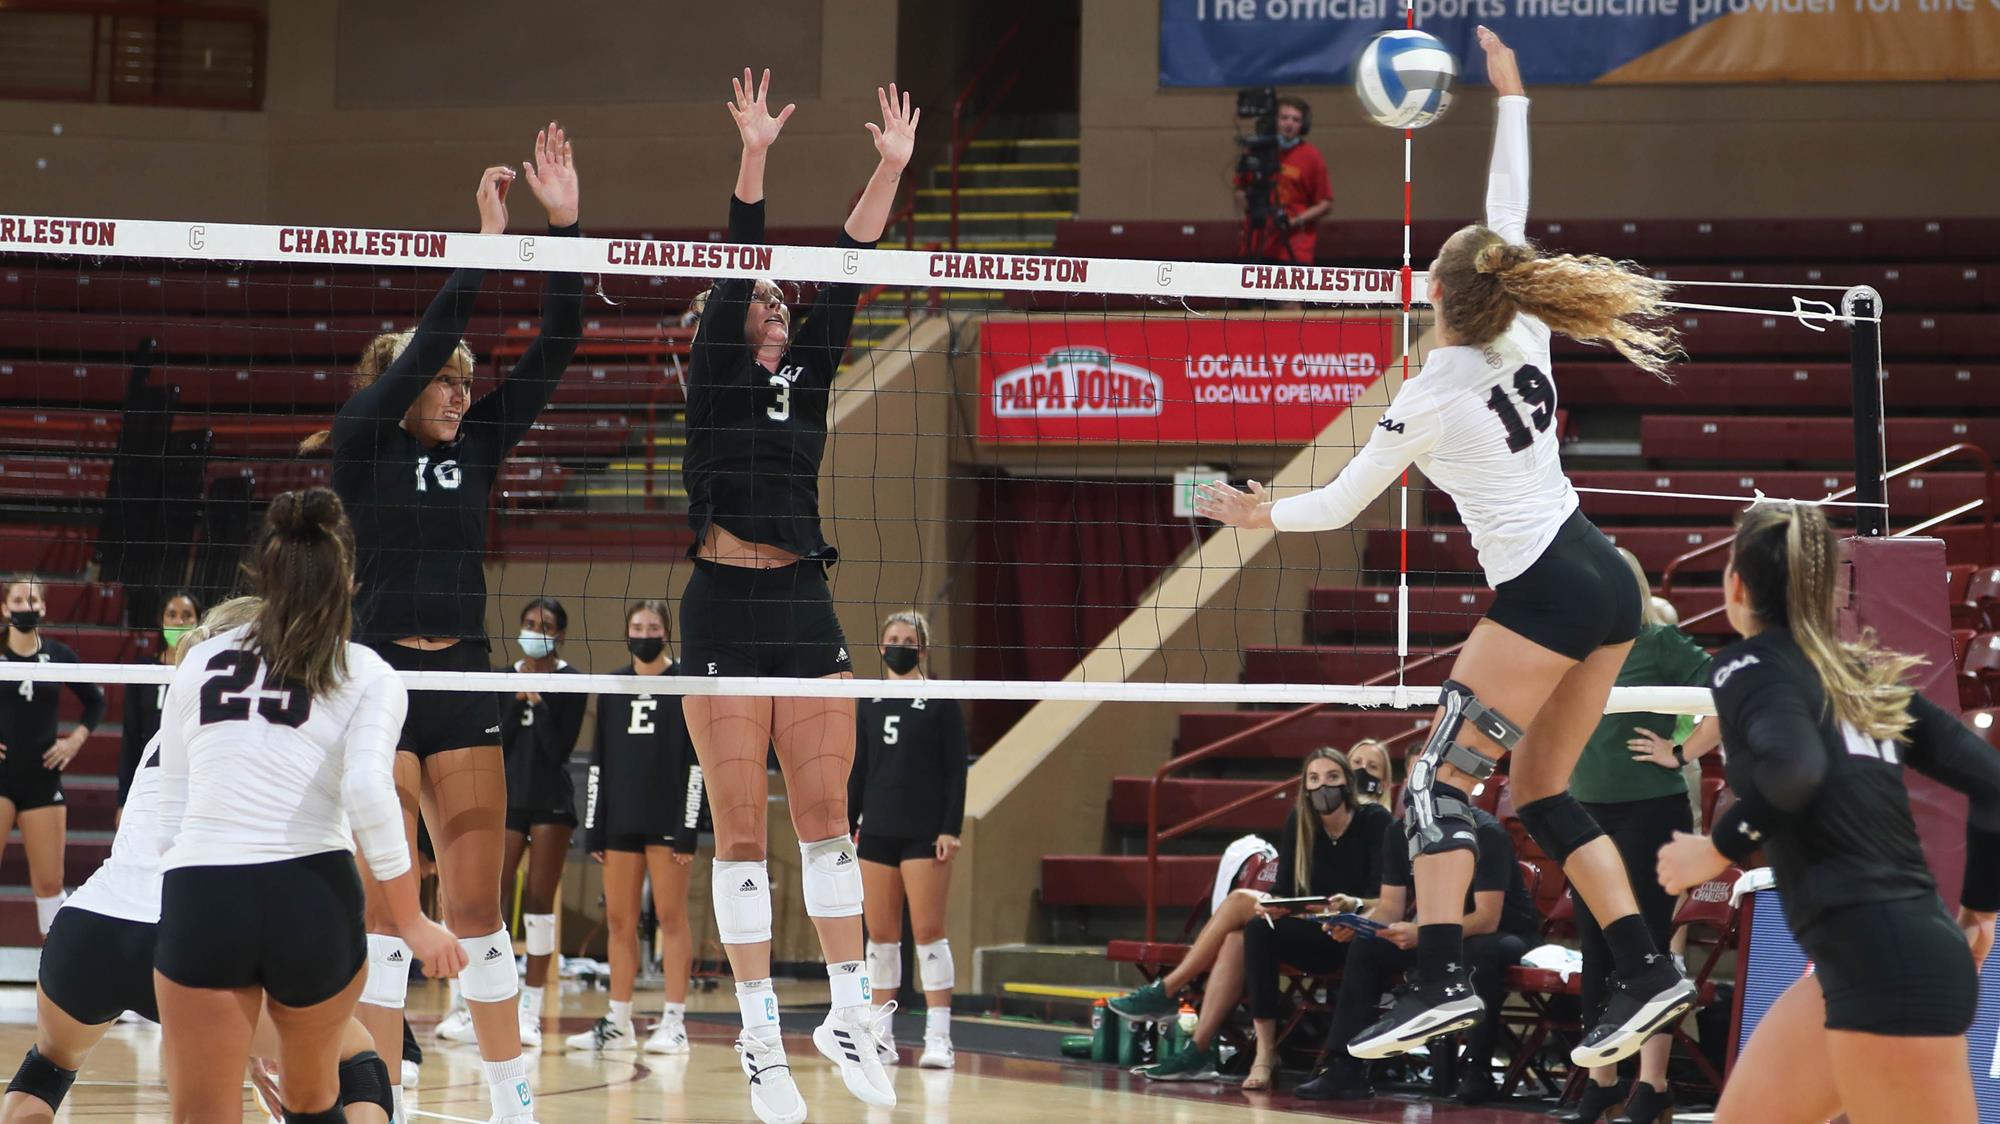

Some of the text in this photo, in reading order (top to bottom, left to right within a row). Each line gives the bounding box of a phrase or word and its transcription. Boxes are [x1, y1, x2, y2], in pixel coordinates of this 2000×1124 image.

[279, 228, 447, 258] CHARLESTON
[607, 240, 773, 271] CHARLESTON
[929, 254, 1089, 283] CHARLESTON
[1240, 265, 1396, 292] CHARLESTON
[1186, 354, 1287, 379] LOCALLY
[766, 374, 791, 421] 3
[1000, 370, 1156, 410] PAPA JOHNS
[1194, 385, 1272, 403] LOCALLY
[1487, 363, 1556, 454] 19
[18, 679, 34, 702] 4
[200, 649, 314, 729] 25
[628, 700, 658, 734] E
[883, 715, 900, 745] 5
